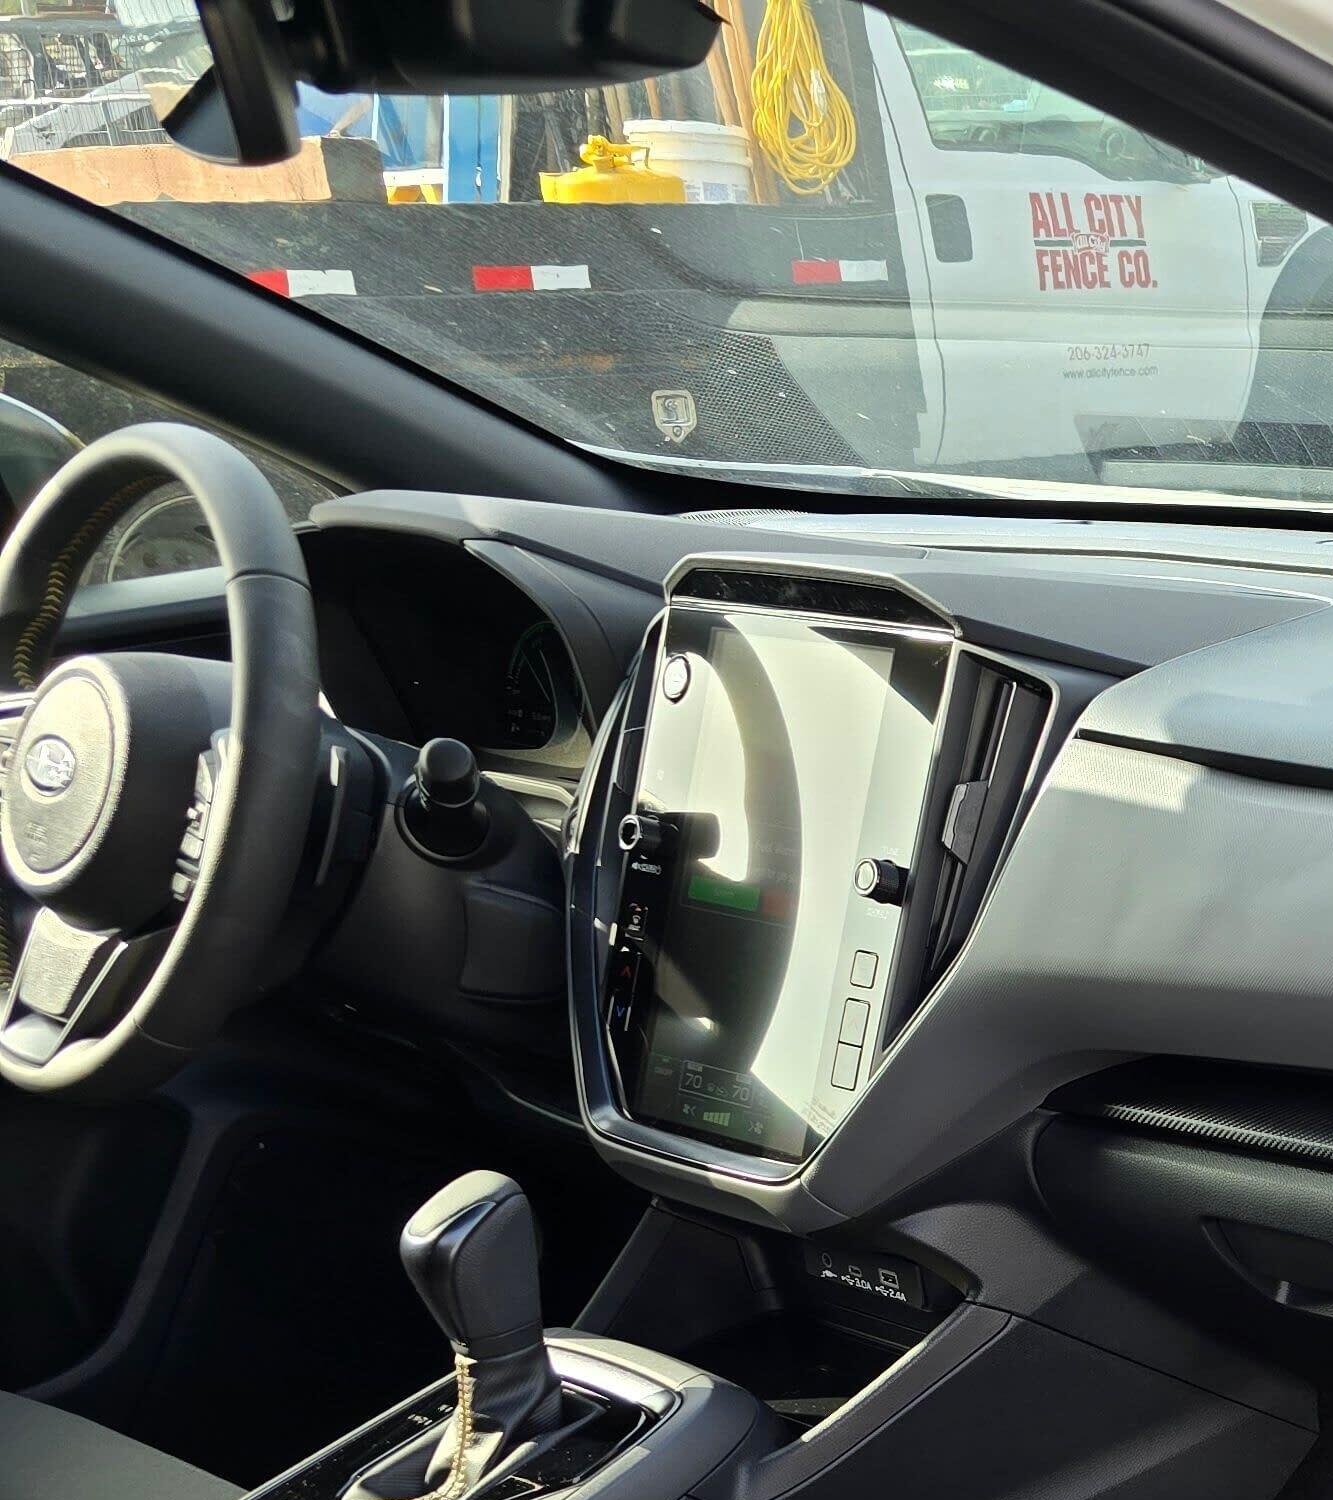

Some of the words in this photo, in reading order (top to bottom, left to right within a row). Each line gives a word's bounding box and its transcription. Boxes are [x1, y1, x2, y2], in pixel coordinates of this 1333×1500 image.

[1029, 192, 1080, 238] ALL
[1084, 192, 1145, 238] CITY
[1036, 249, 1111, 291] FENCE
[1117, 249, 1158, 288] CO.
[1067, 343, 1150, 361] 206-324-3747
[684, 1073, 702, 1089] 70
[732, 1085, 750, 1101] 70
